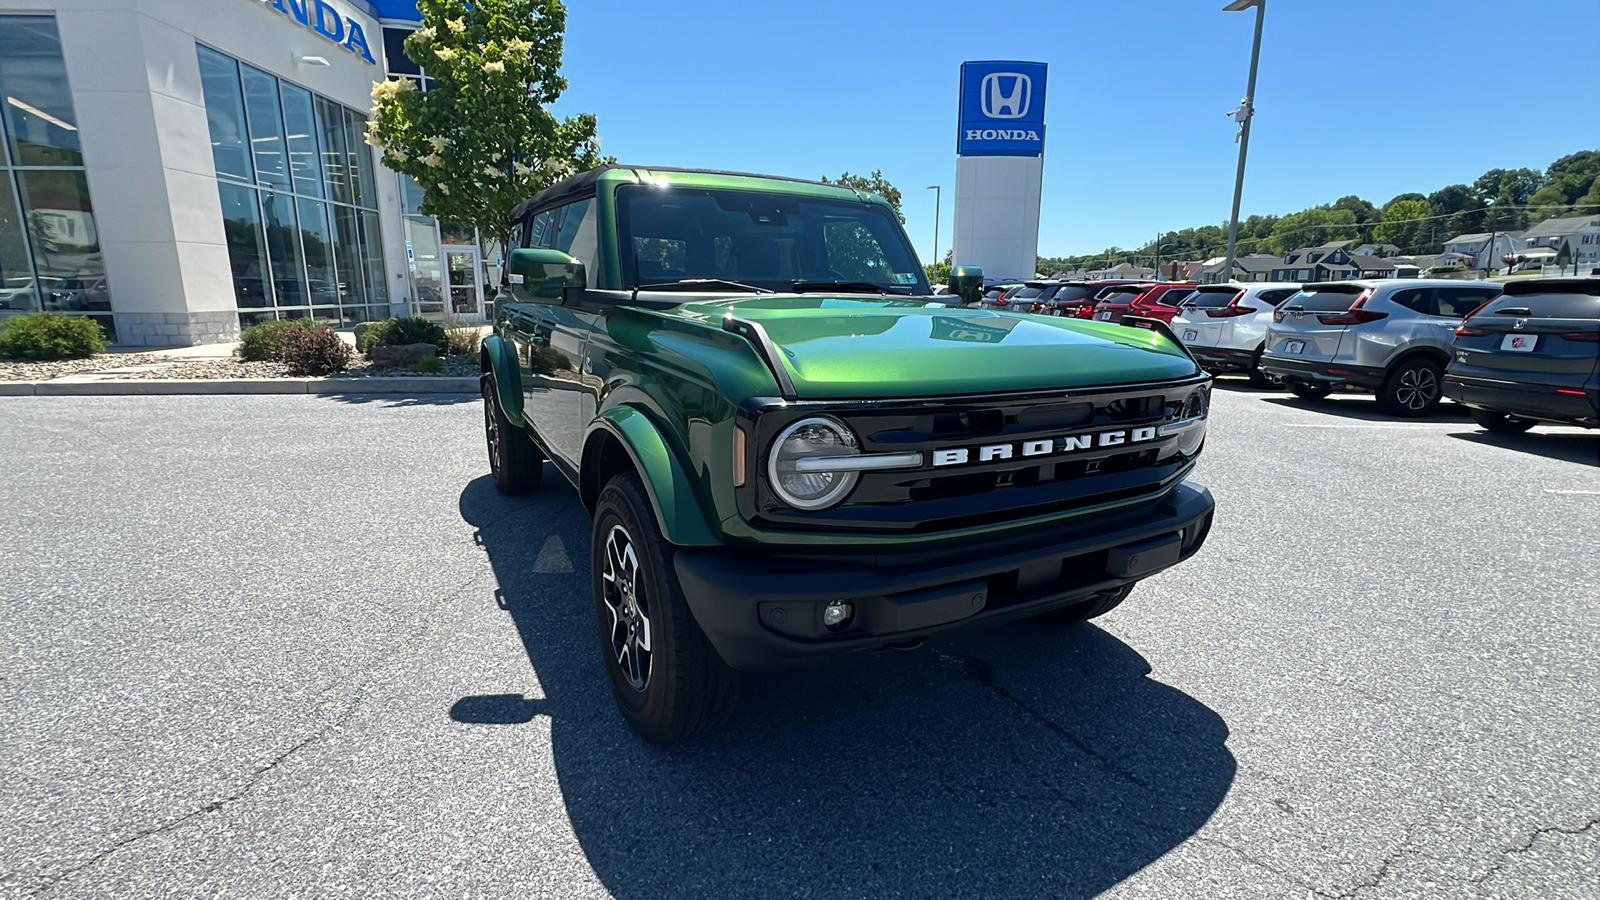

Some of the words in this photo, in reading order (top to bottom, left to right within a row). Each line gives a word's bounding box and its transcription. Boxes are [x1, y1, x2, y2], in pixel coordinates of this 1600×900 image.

[271, 0, 376, 66] NDA
[965, 129, 1040, 141] HONDA
[932, 426, 1156, 467] BRONCO
